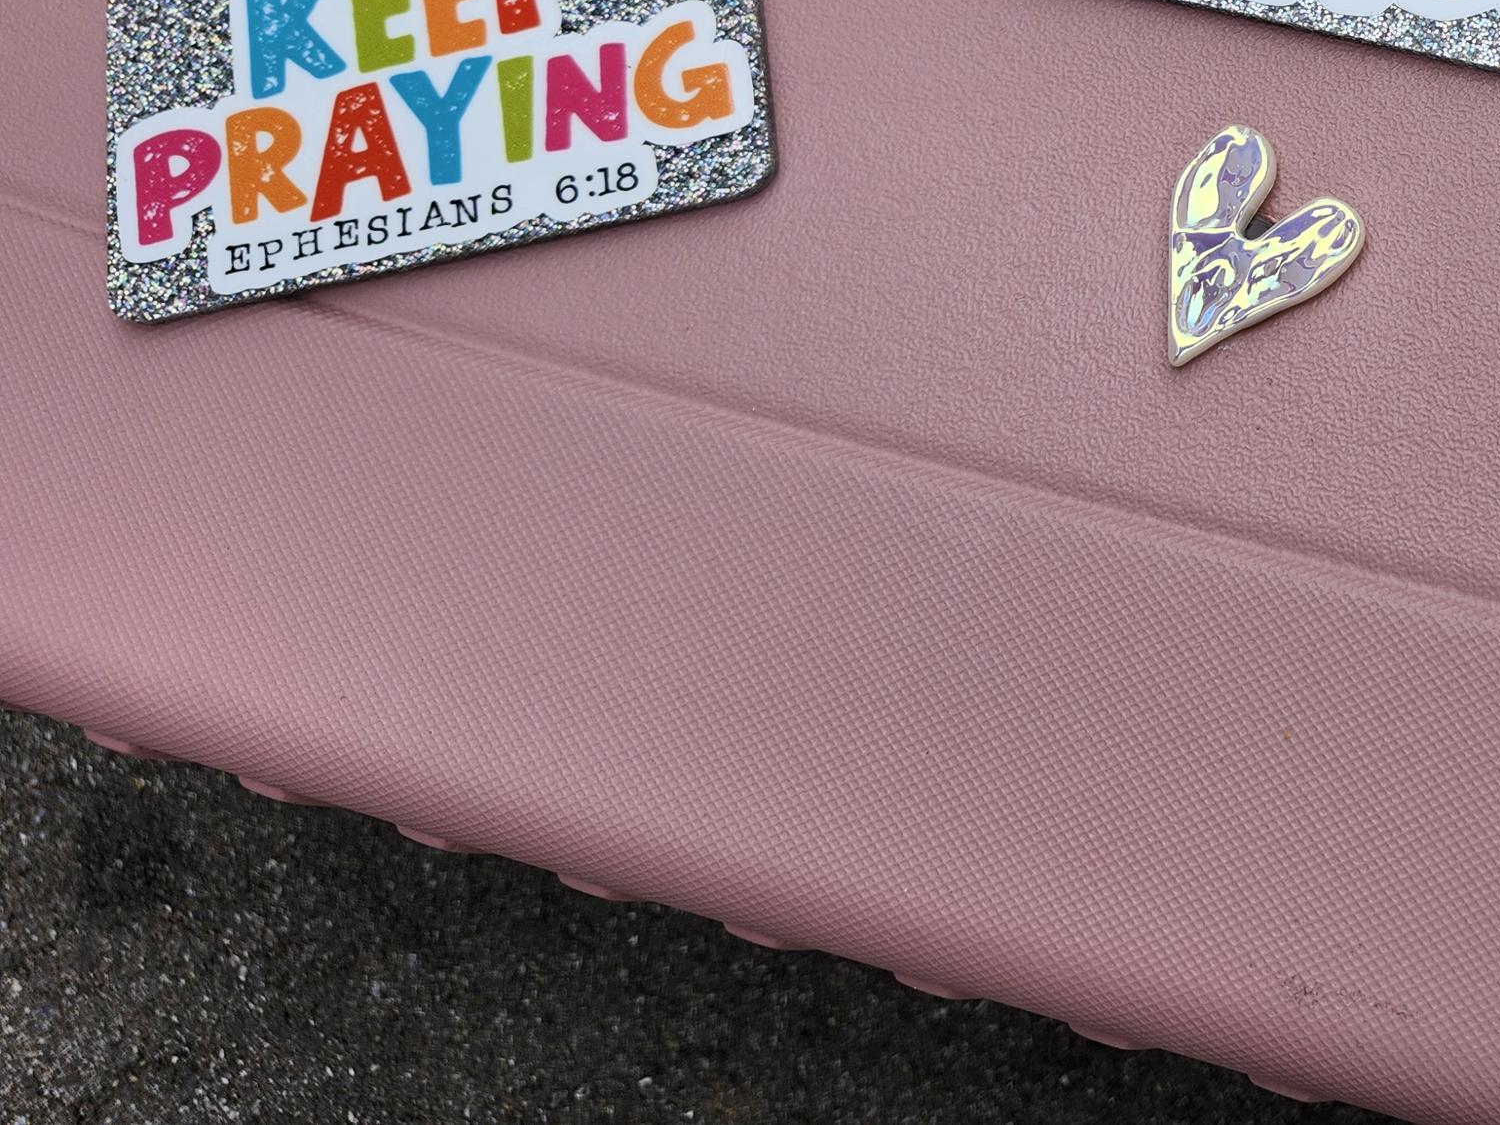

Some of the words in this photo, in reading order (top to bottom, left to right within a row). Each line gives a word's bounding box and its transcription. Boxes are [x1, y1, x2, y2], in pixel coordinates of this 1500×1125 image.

[133, 19, 735, 246] PRAYING
[225, 183, 514, 275] EPHESIANS
[555, 161, 640, 204] 6:18
